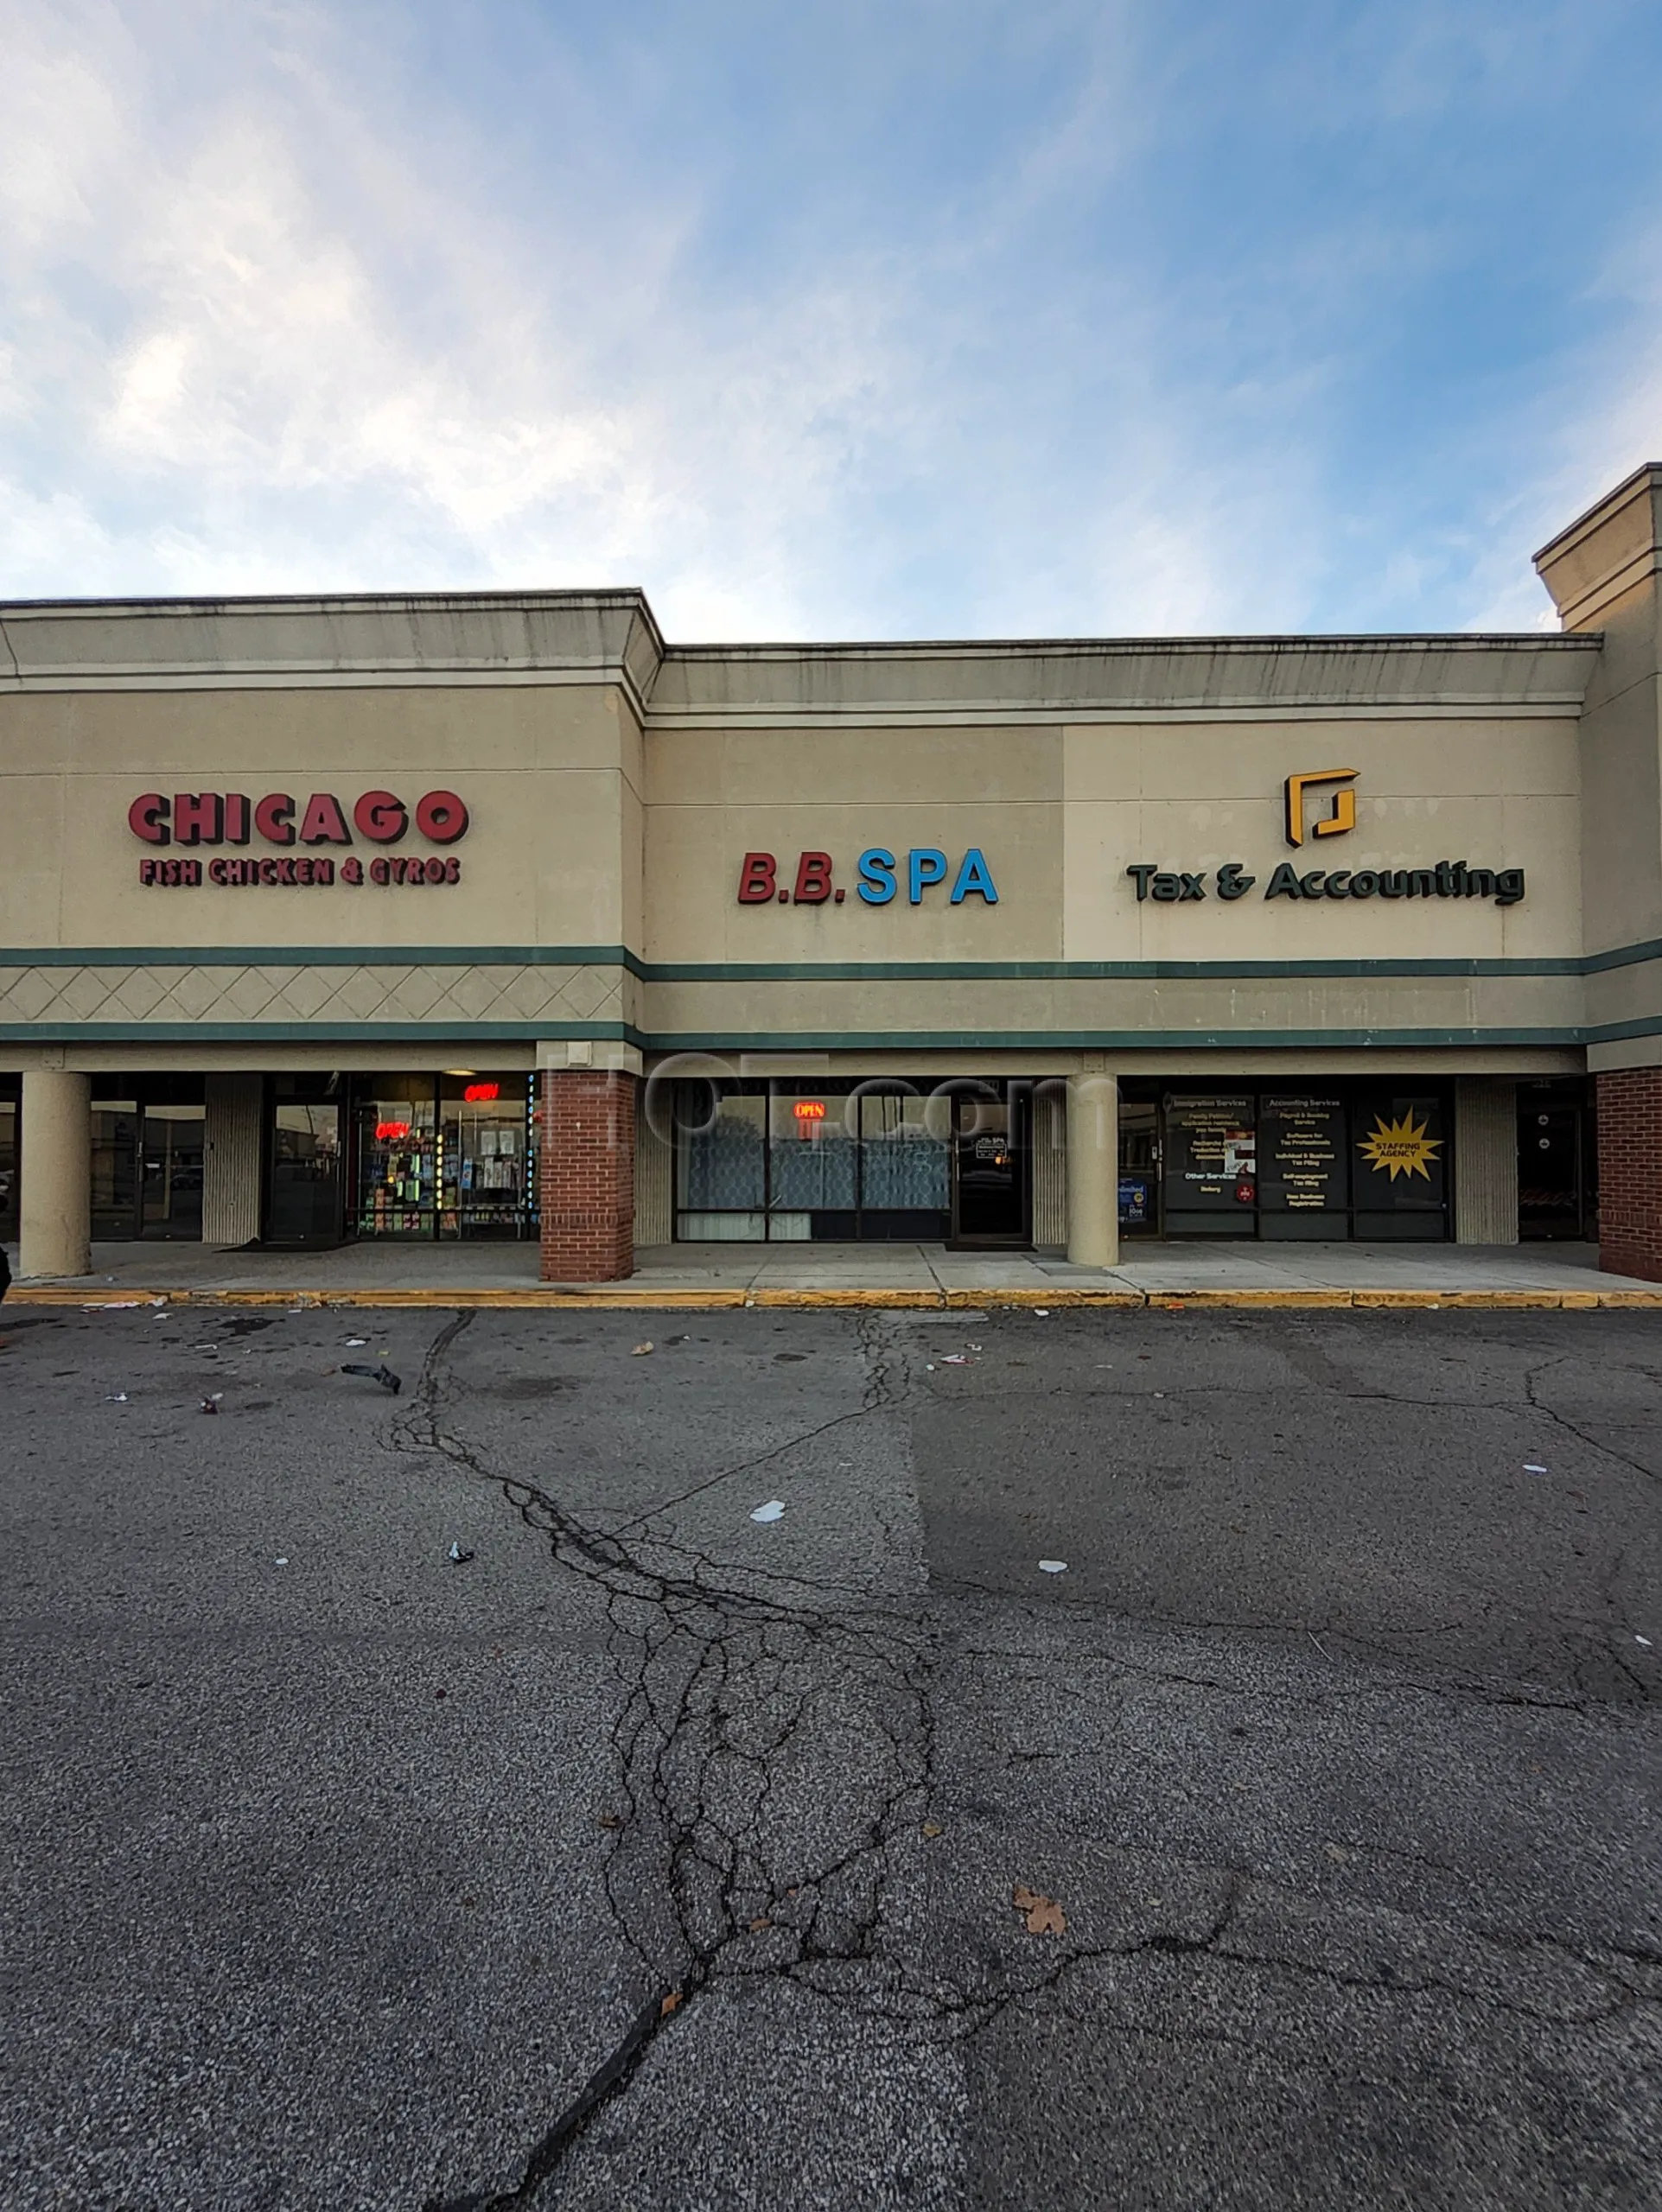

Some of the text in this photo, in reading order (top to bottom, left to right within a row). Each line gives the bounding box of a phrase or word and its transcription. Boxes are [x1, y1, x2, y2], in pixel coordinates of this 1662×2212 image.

[128, 790, 468, 846] CHICAGO
[140, 856, 460, 887] FISH CHICKEN & GYROS
[737, 849, 999, 905] B.B. SPA
[1127, 861, 1525, 906] Tax & Accounting
[464, 1084, 499, 1102] OPEN
[796, 1104, 824, 1117] OPEN
[375, 1122, 409, 1140] OPEN
